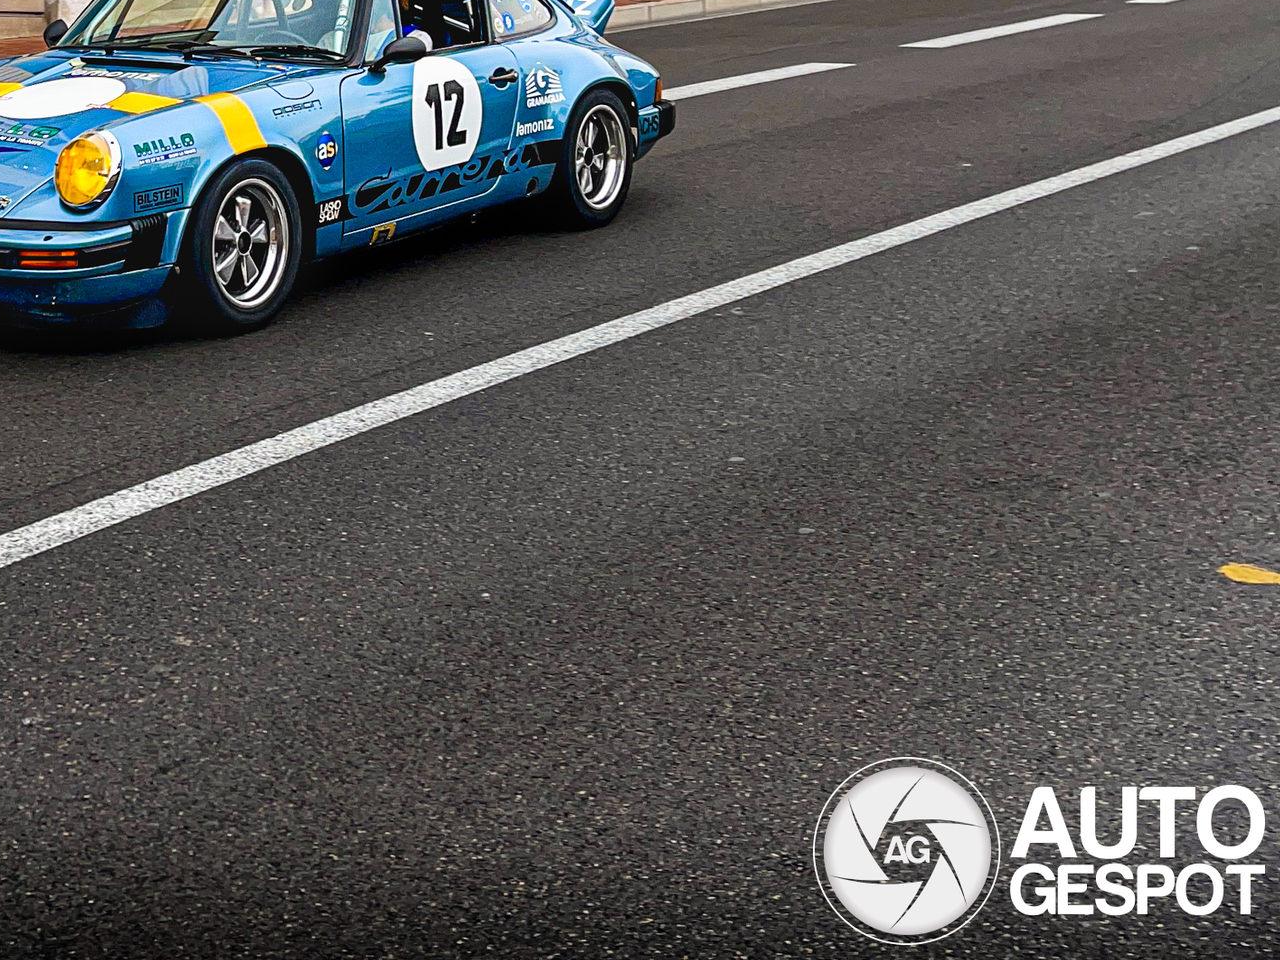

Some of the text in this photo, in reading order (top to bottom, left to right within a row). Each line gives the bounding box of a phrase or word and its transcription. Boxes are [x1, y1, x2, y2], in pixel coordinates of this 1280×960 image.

[424, 79, 467, 151] 12
[133, 133, 195, 157] MILLO
[319, 141, 335, 160] as
[348, 143, 533, 217] Carrera
[137, 187, 180, 205] BILSTEIN
